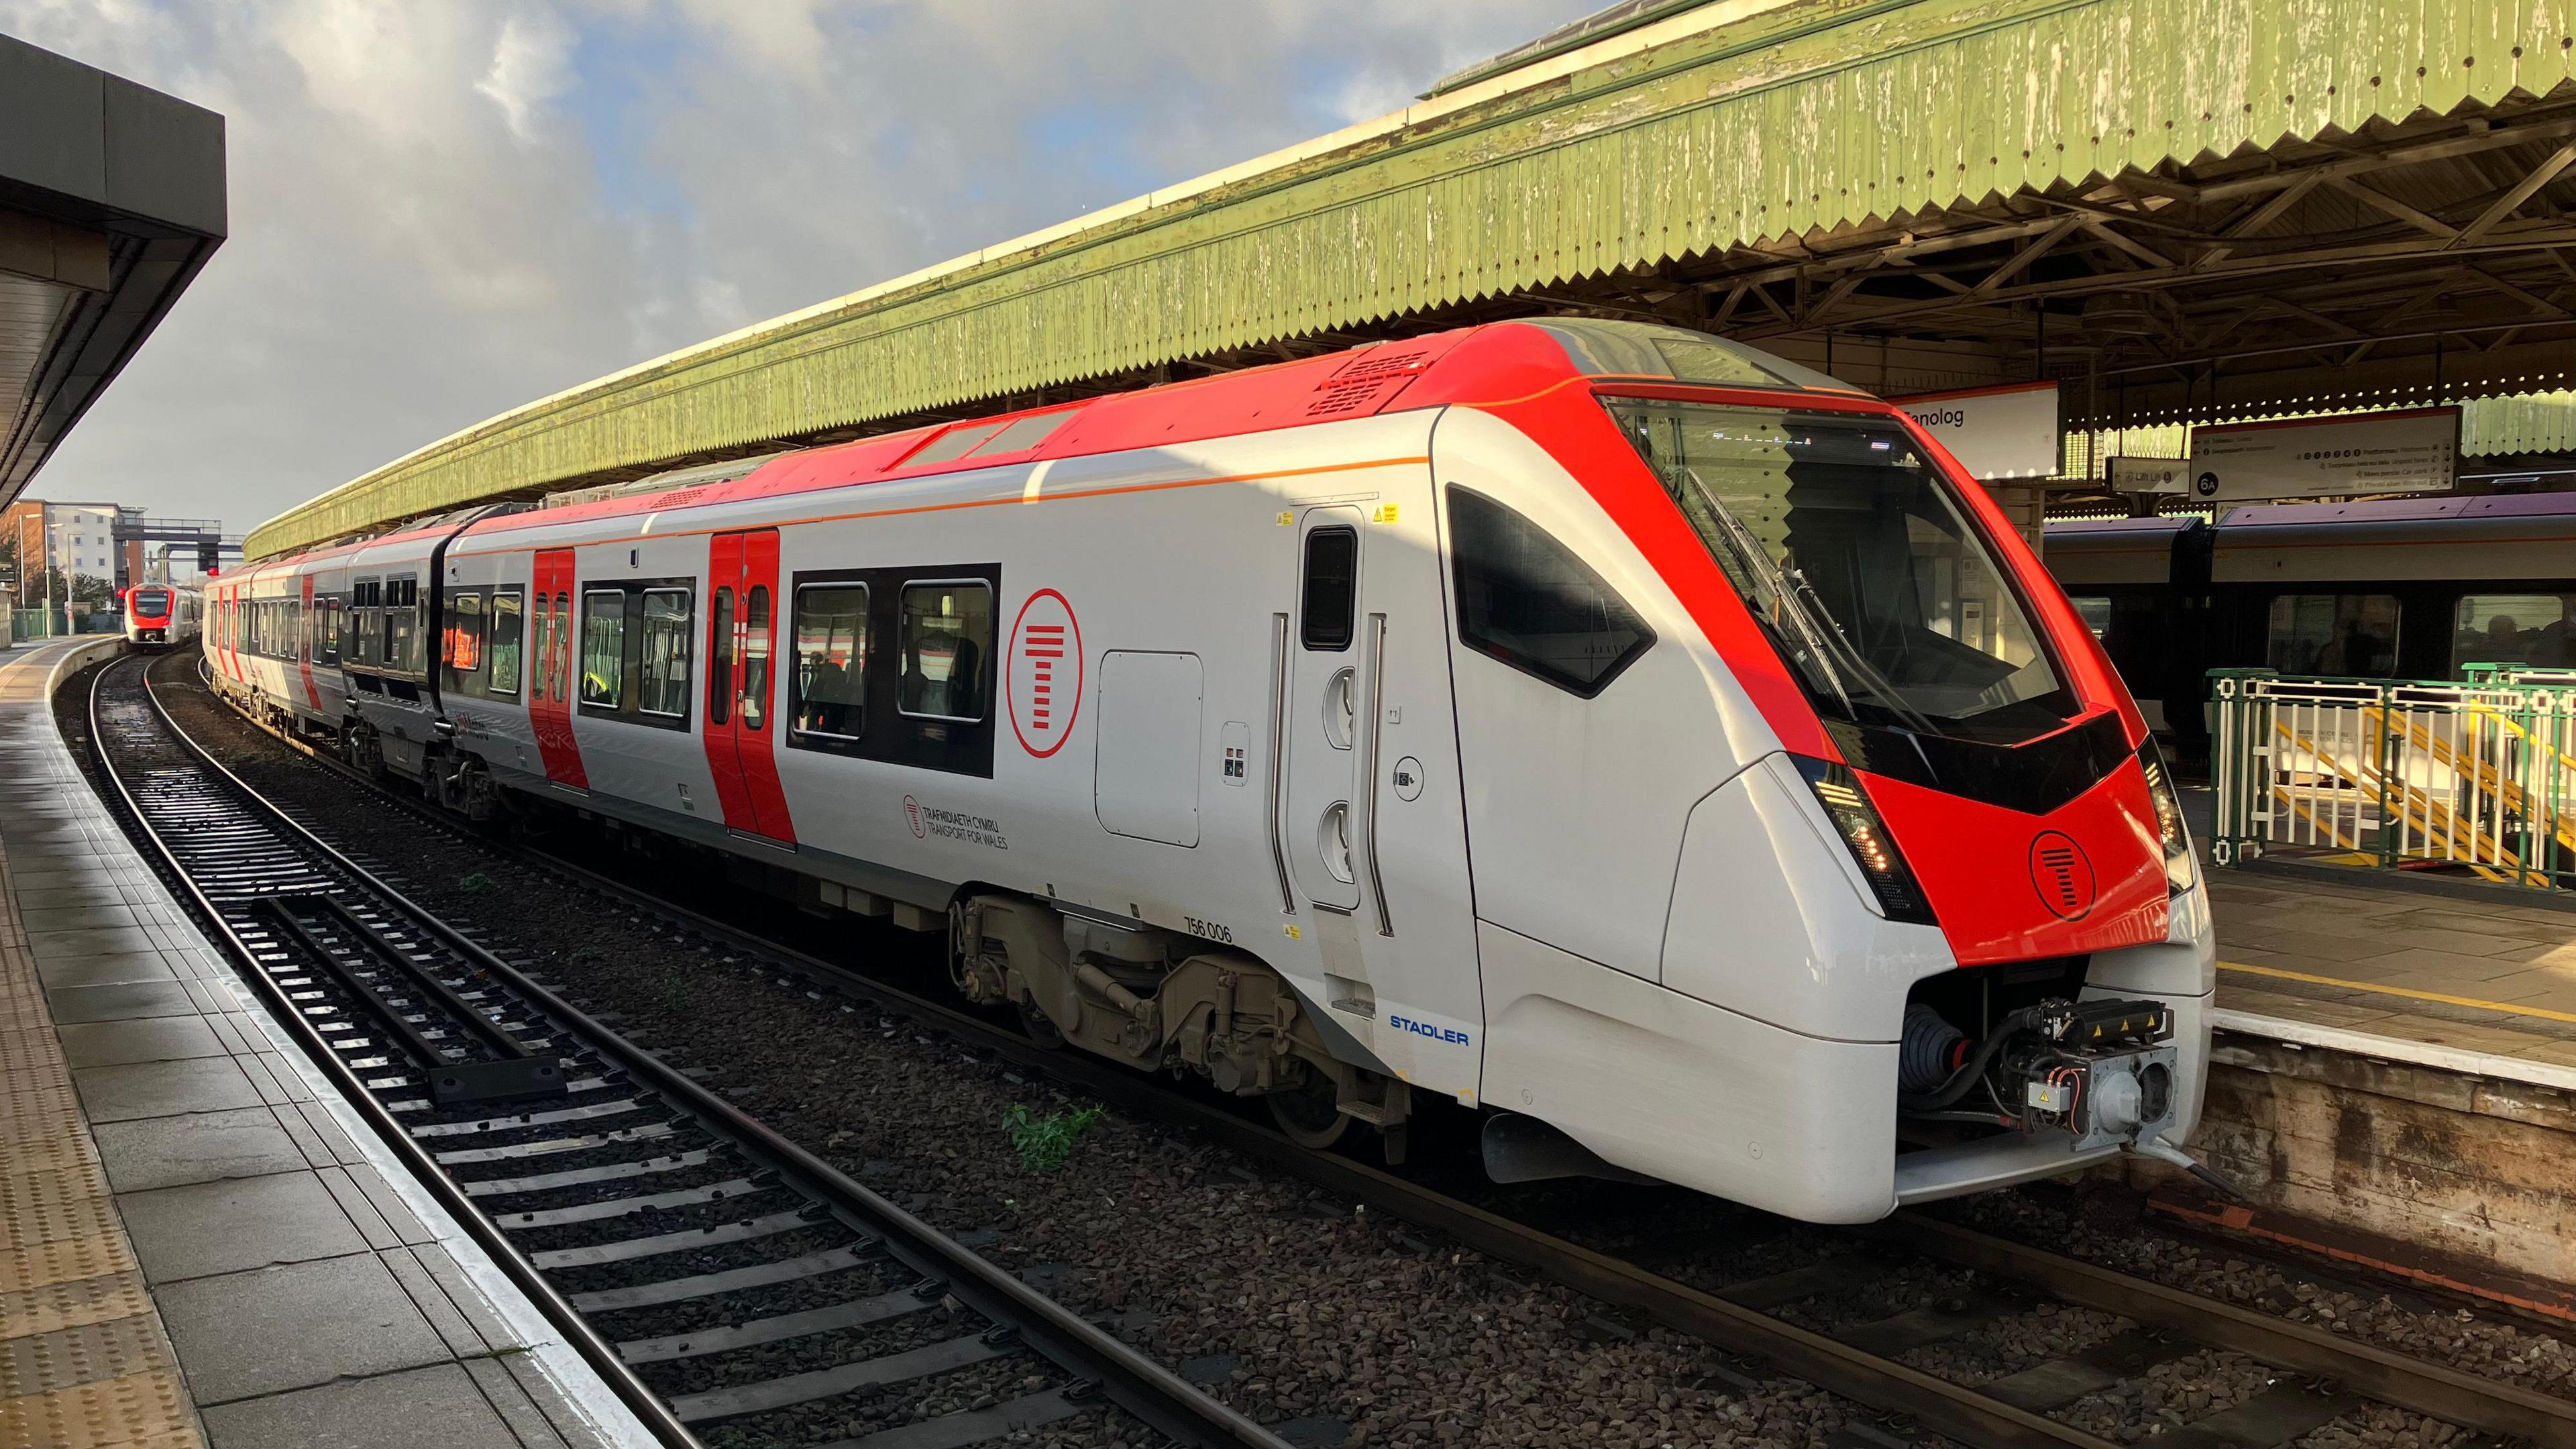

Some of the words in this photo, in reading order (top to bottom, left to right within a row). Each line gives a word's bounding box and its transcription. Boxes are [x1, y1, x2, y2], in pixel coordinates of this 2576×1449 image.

[2200, 478, 2216, 490] 6A
[922, 806, 972, 828] TRAFNIDIAETH
[973, 816, 999, 833] CYMRU
[926, 822, 967, 840] TRANSPORT
[967, 830, 983, 844] FOR
[981, 834, 1008, 850] WALES
[1183, 916, 1205, 936] 756
[1208, 922, 1232, 943] 006
[1390, 1015, 1469, 1046] STADLER
